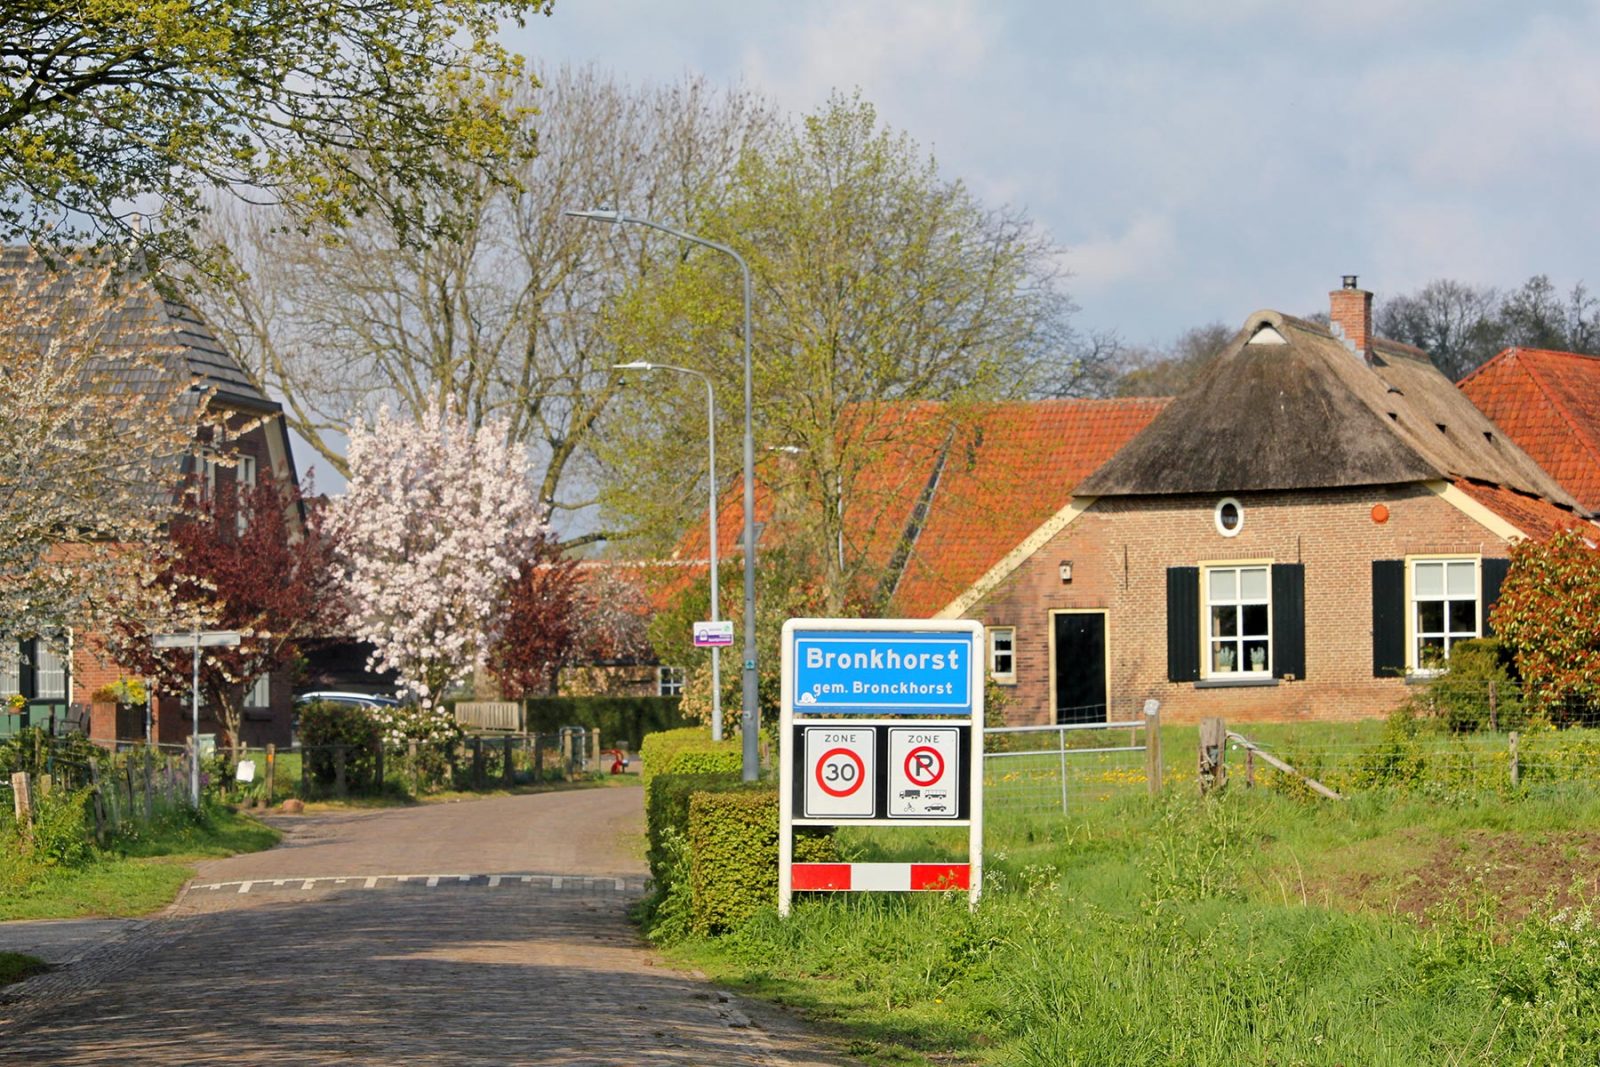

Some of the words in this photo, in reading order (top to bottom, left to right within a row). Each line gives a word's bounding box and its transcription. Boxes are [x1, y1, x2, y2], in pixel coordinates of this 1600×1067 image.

[806, 648, 959, 670] Bronkhorst
[813, 682, 848, 697] gem.
[852, 681, 953, 694] Bronckhorst
[824, 734, 857, 743] ZONE
[908, 735, 940, 744] ZONE
[825, 763, 856, 781] 30
[915, 754, 934, 777] P
